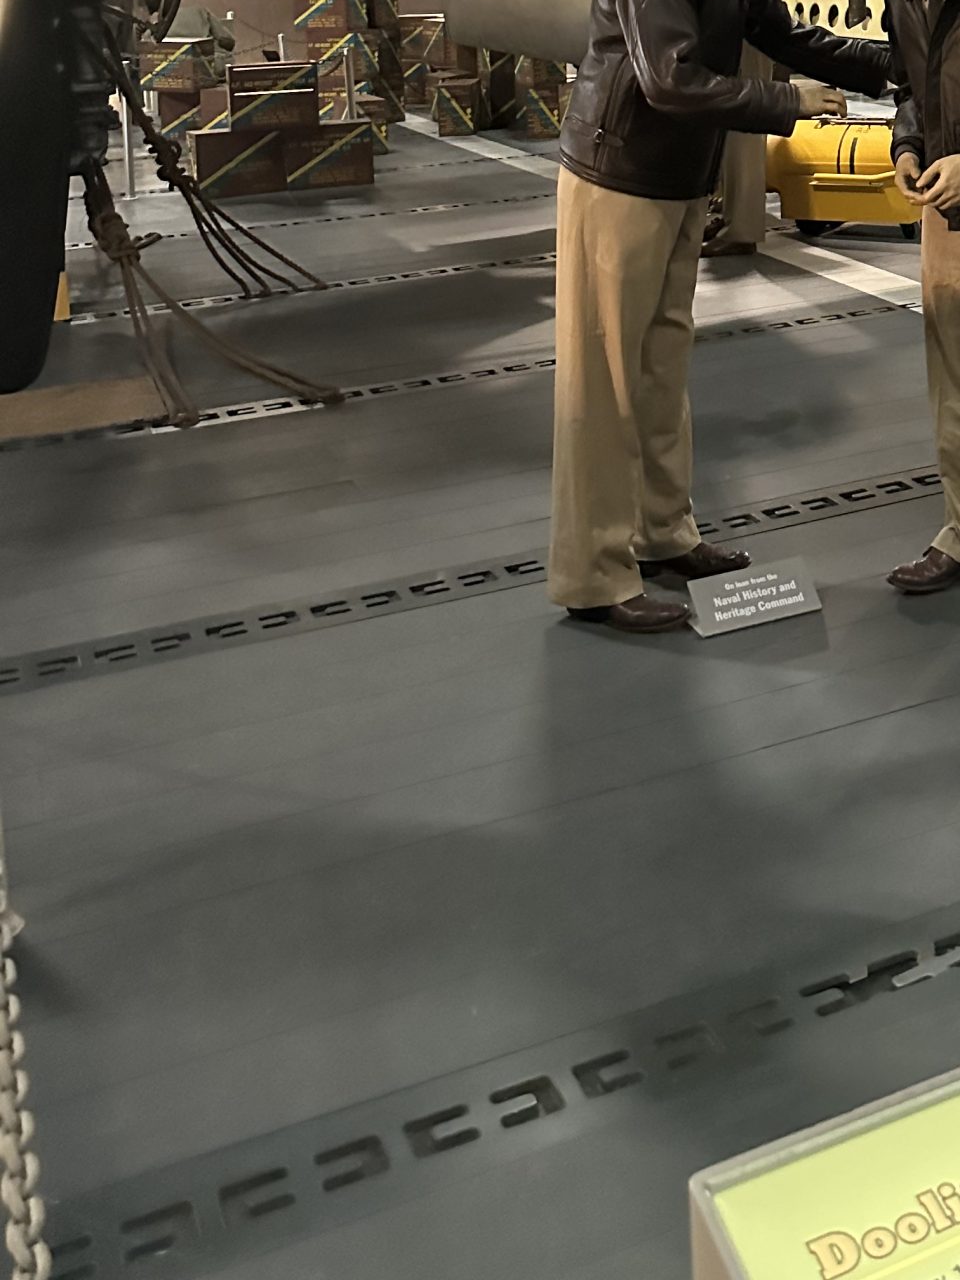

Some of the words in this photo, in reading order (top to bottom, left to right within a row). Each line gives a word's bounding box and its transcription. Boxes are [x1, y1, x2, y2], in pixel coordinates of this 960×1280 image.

[766, 573, 778, 581] the
[713, 592, 741, 607] Naval
[742, 586, 777, 600] History
[778, 580, 797, 592] and
[714, 605, 756, 621] Heritage
[757, 592, 804, 611] Command
